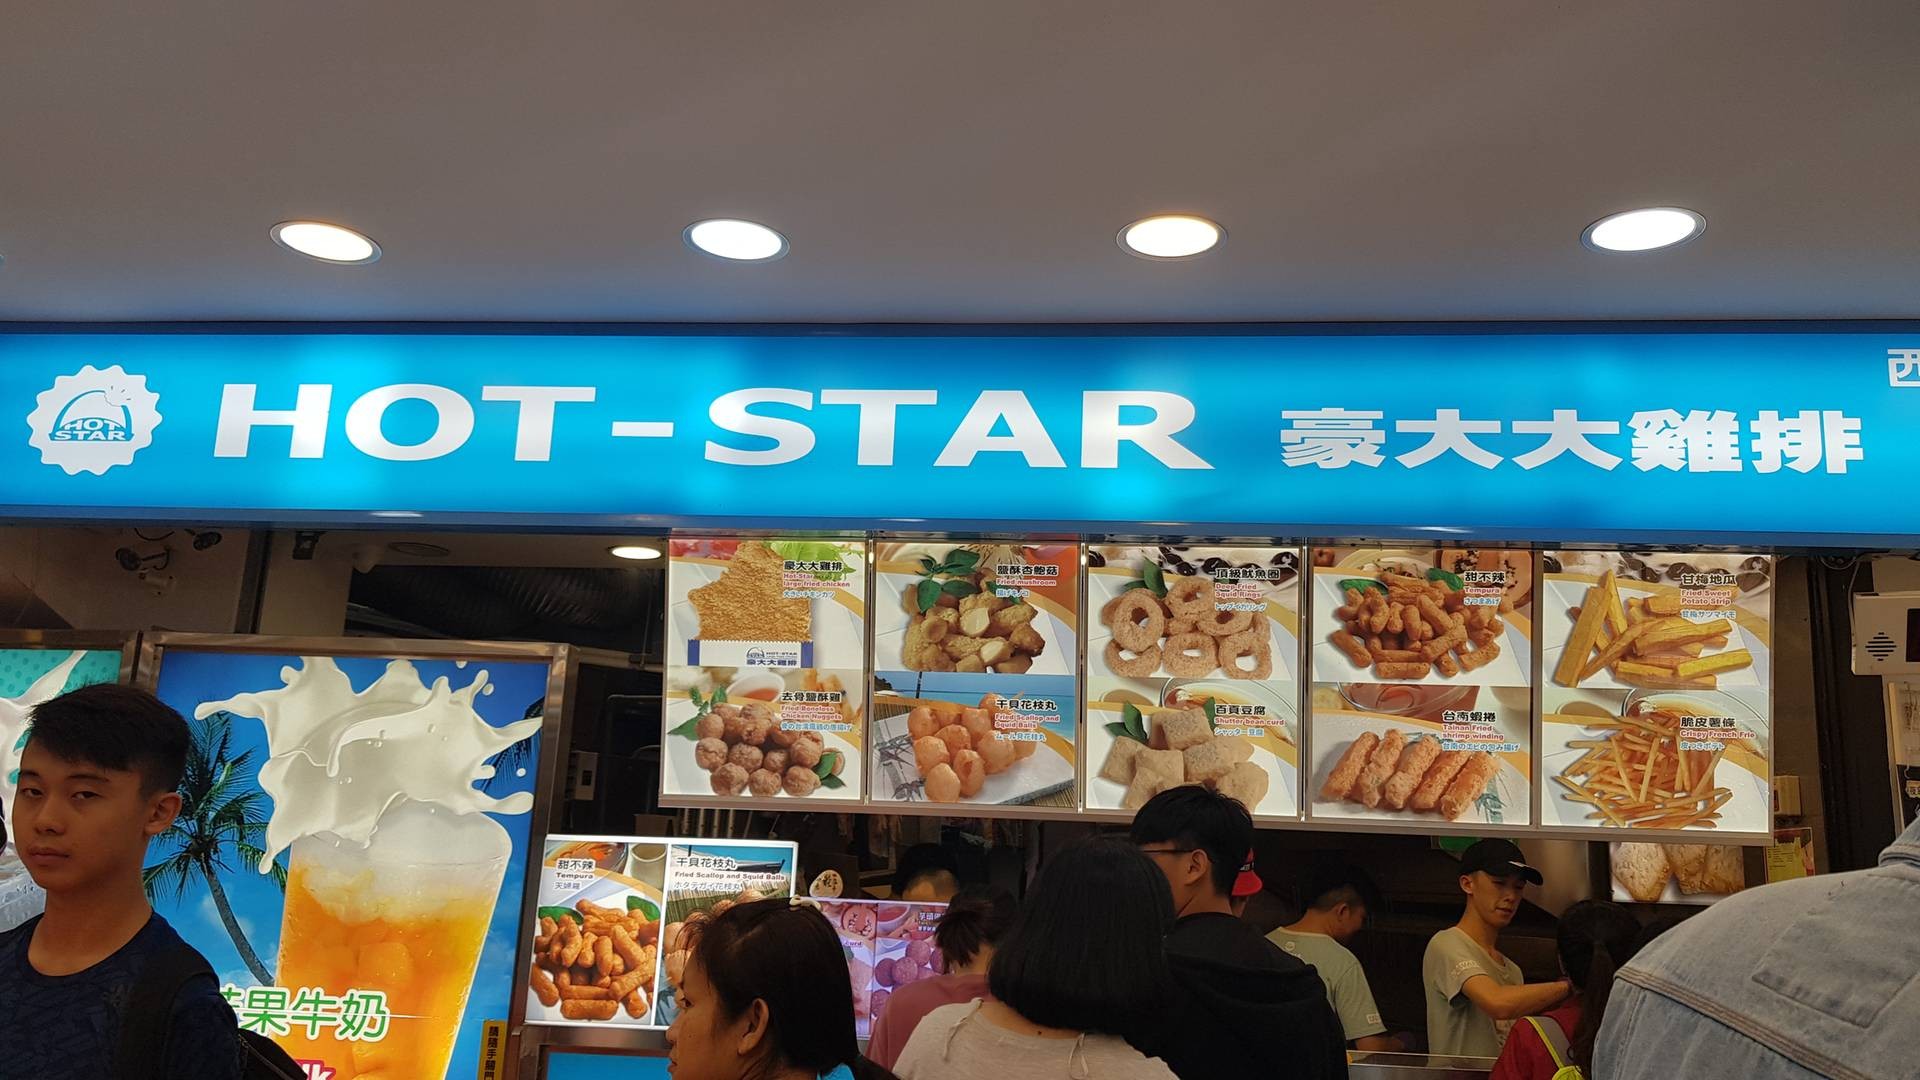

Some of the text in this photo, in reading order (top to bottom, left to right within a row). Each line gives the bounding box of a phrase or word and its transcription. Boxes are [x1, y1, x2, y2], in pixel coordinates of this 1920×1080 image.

[64, 419, 119, 430] HOT
[54, 431, 126, 441] STAR
[1281, 408, 1863, 474] 豪大大雞排
[784, 561, 843, 571] 豪大大雞排
[997, 565, 1058, 575] 鹽酥杏鮑菇
[1216, 569, 1280, 579] 頂級魷魚圈
[1465, 572, 1505, 582] 甜不辣
[1682, 574, 1737, 585] 甘梅地瓜
[1239, 591, 1261, 599] Rings
[1710, 598, 1731, 606] Strip
[781, 692, 841, 702] 去骨鹽酥雞
[996, 699, 1057, 711] 干貝花枝丸
[1443, 711, 1496, 722] 台南蝦捲
[1681, 716, 1735, 728] 脆皮薯條
[1680, 730, 1707, 739] Crispy
[557, 860, 594, 870] 甜不辣
[676, 857, 736, 869] 干貝花枝丸
[742, 873, 764, 881] Squid
